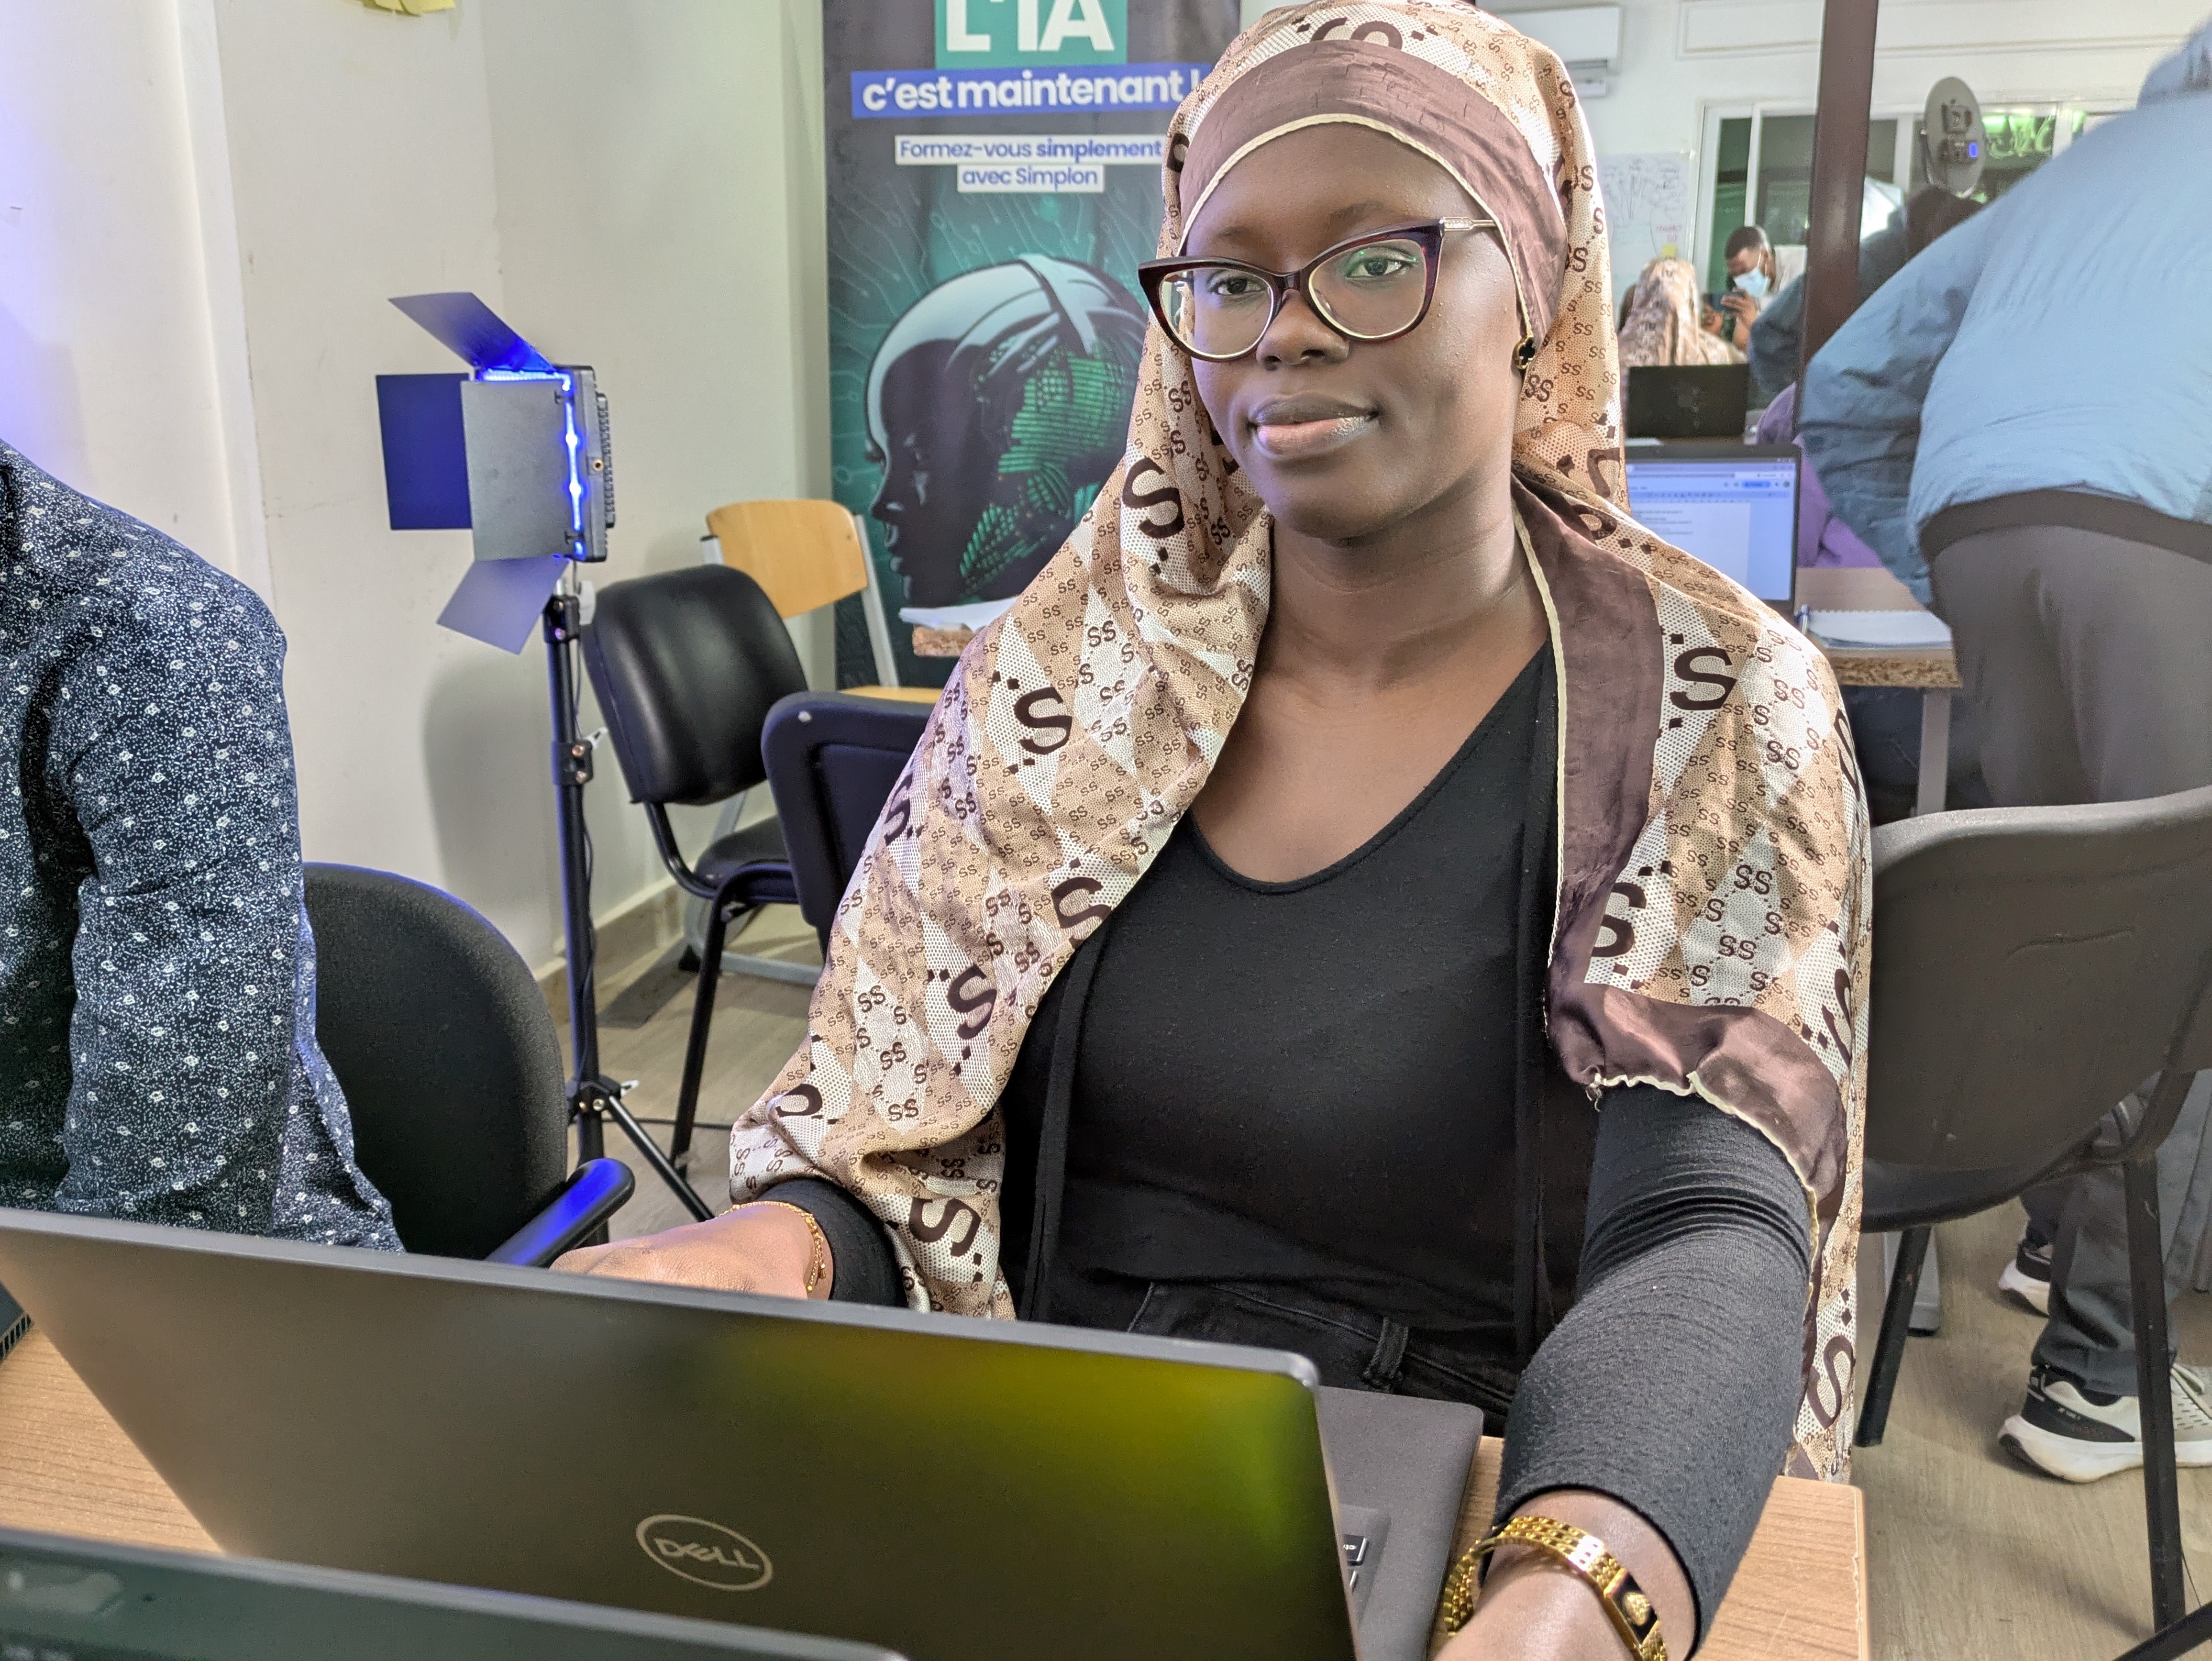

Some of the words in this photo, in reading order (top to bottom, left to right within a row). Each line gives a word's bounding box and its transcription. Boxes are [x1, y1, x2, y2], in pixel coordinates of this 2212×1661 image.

[946, 0, 1115, 52] LIA
[959, 70, 1183, 109] maintenant
[900, 140, 1032, 158] Formez-vous
[1036, 138, 1161, 164] simplement
[962, 169, 1011, 185] avec
[1015, 167, 1098, 190] Simplon
[1123, 458, 1185, 538] S
[1670, 647, 1737, 710] S
[1014, 687, 1072, 755] S
[948, 963, 997, 1040] S
[654, 1538, 760, 1570] DELL
